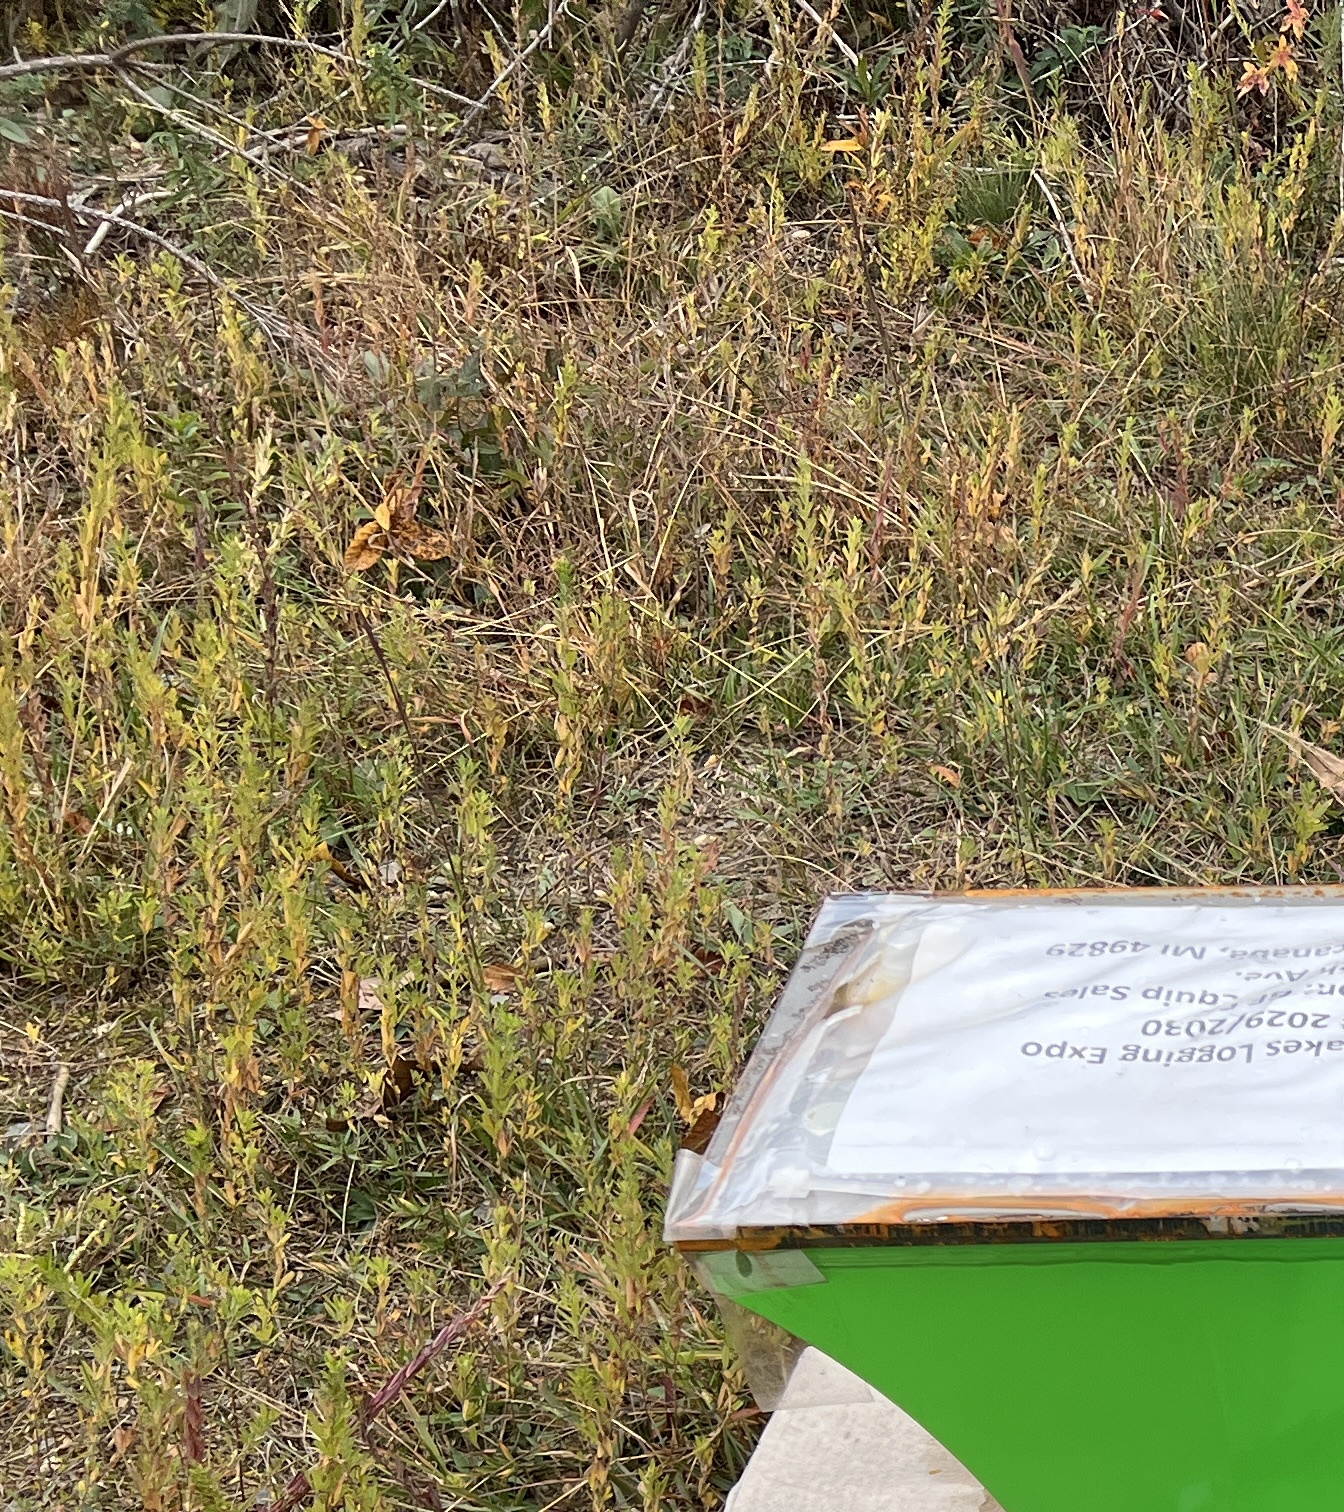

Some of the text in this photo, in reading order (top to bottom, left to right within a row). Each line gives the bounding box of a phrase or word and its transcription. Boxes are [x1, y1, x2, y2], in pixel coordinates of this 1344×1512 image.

[1045, 940, 1150, 957] 49829
[1161, 944, 1206, 960] MI
[1235, 969, 1310, 982] Ave.
[1044, 985, 1131, 1001] Sales
[1141, 986, 1238, 1011] Equip
[1141, 1010, 1330, 1038] 2029/2030
[1020, 1040, 1108, 1064] Expo
[1119, 1043, 1253, 1067] Logging
